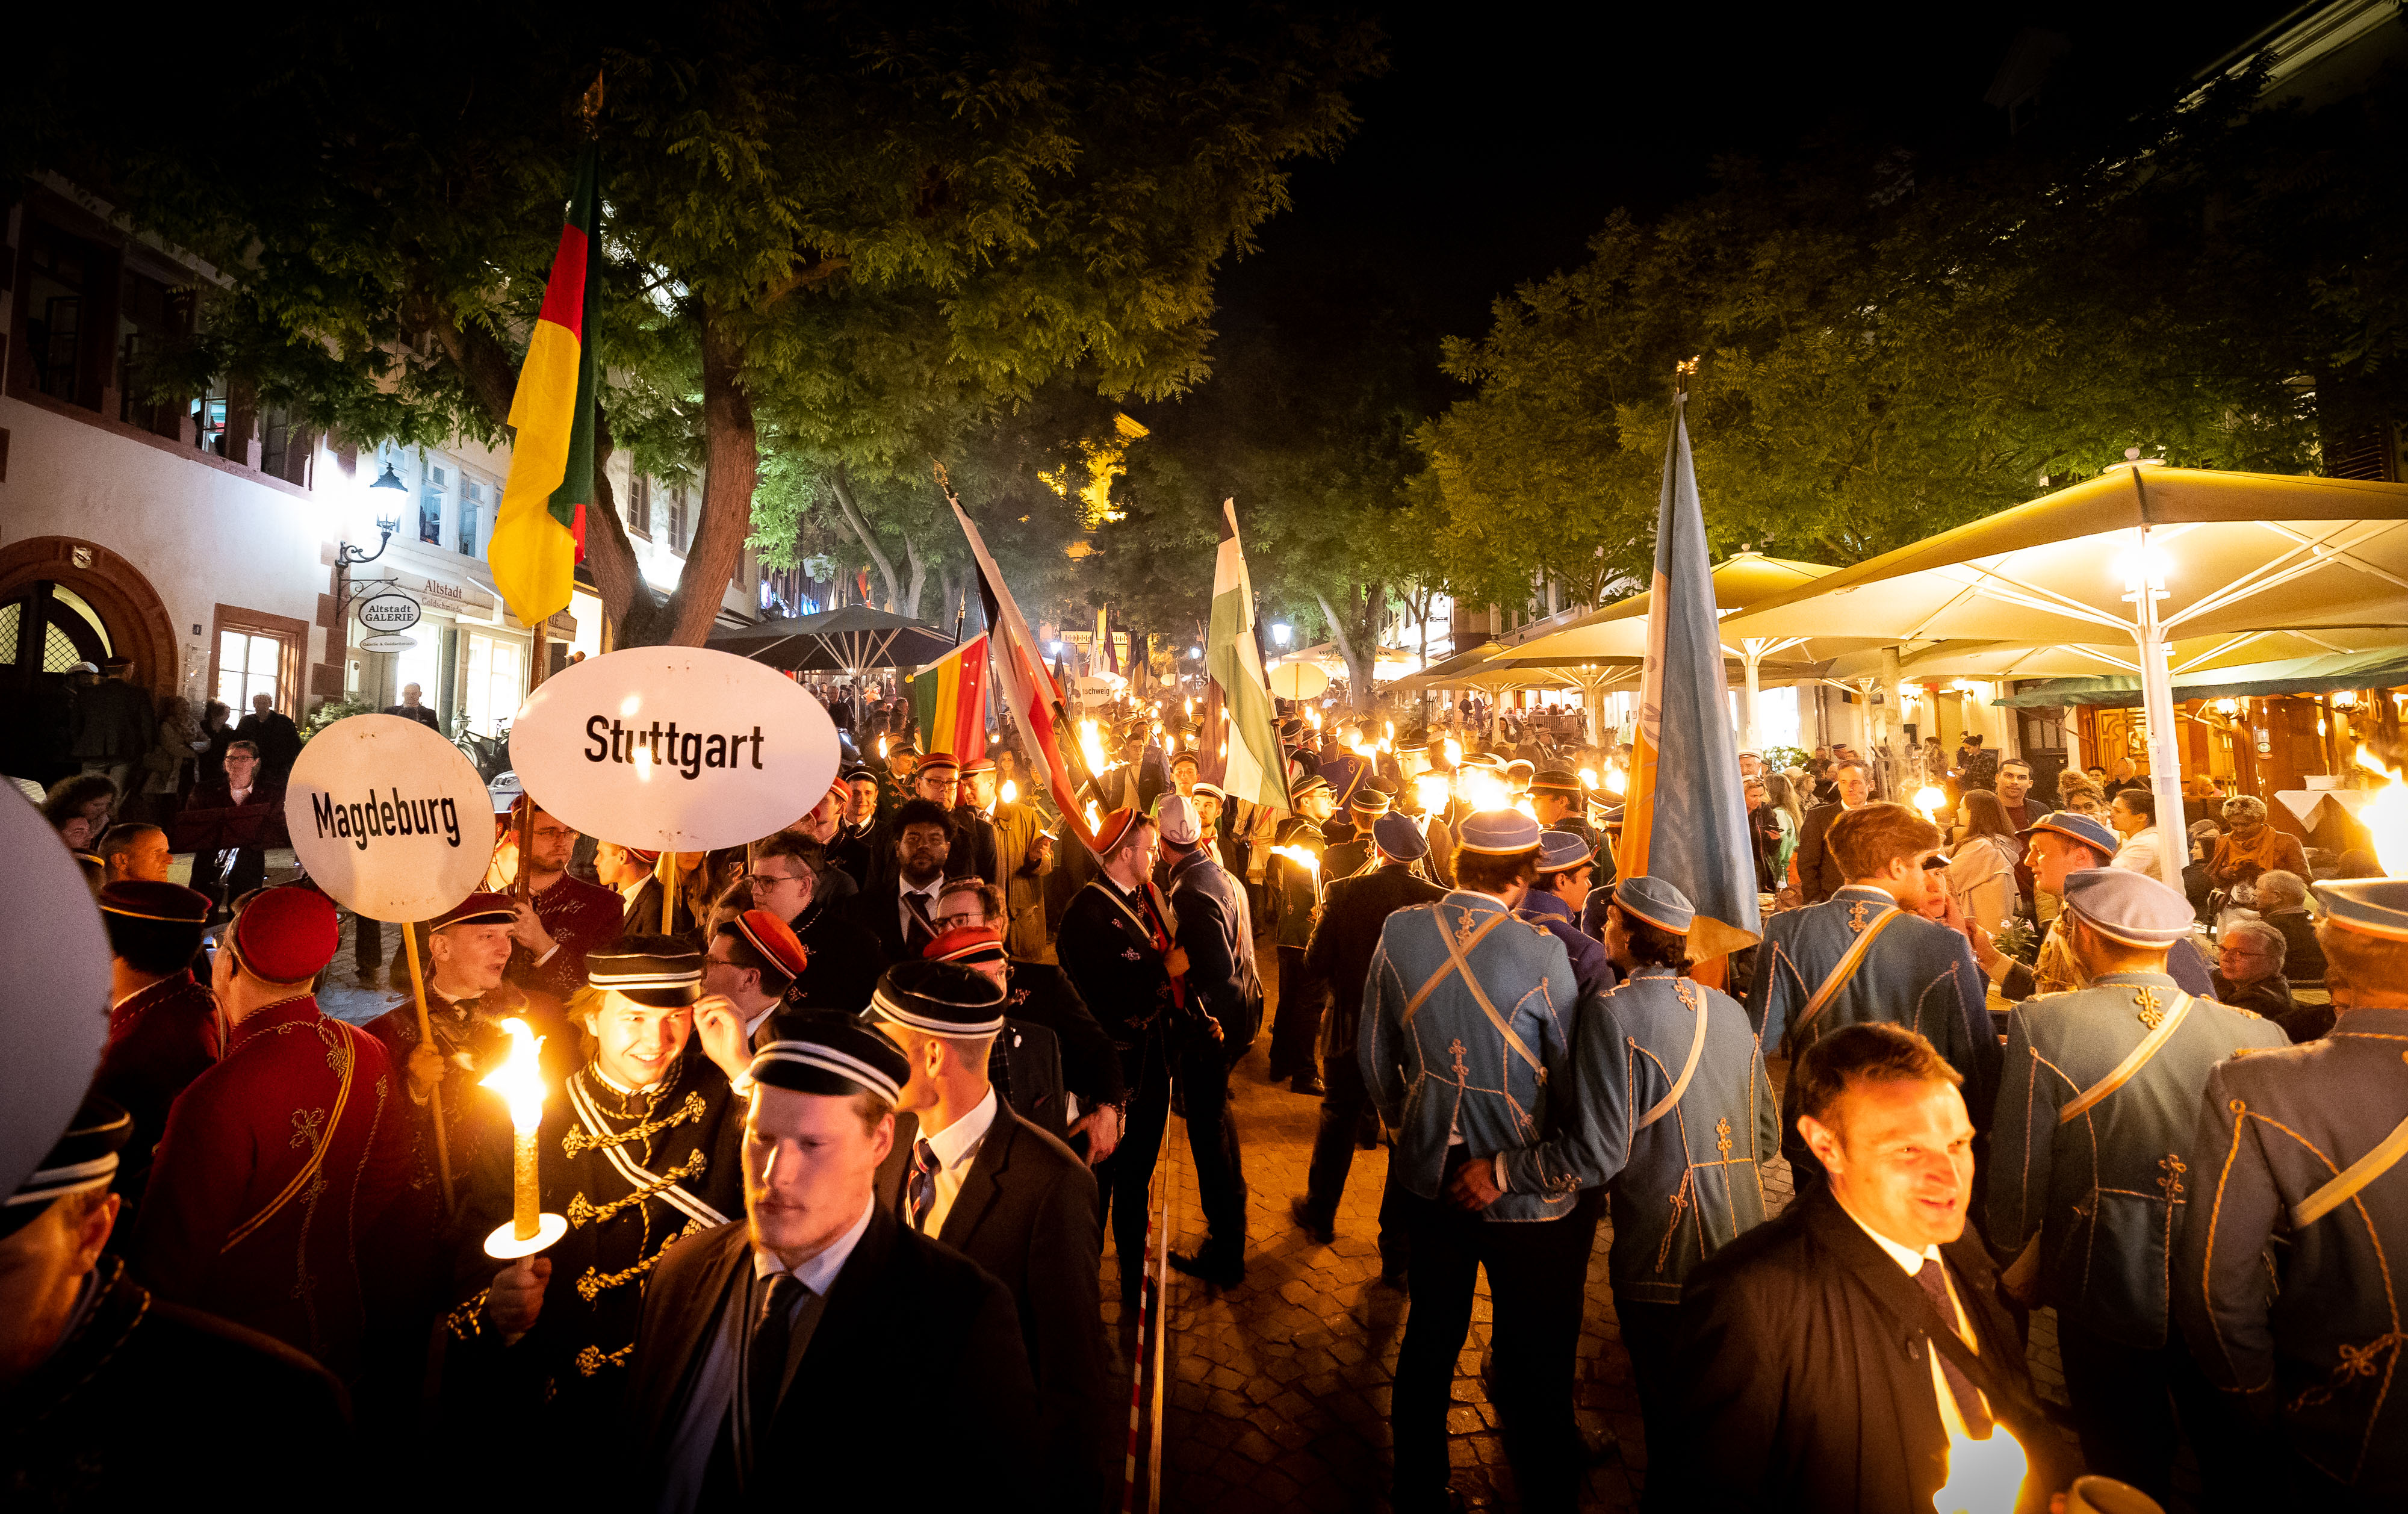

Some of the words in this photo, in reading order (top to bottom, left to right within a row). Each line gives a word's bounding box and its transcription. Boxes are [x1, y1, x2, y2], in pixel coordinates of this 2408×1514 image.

[424, 579, 462, 599] Altstadt
[368, 604, 411, 613] Altstadt
[421, 597, 463, 613] Goldschmiede
[365, 613, 414, 621] GALERIE
[584, 715, 765, 780] Stuttgart
[311, 787, 461, 851] Magdeburg
